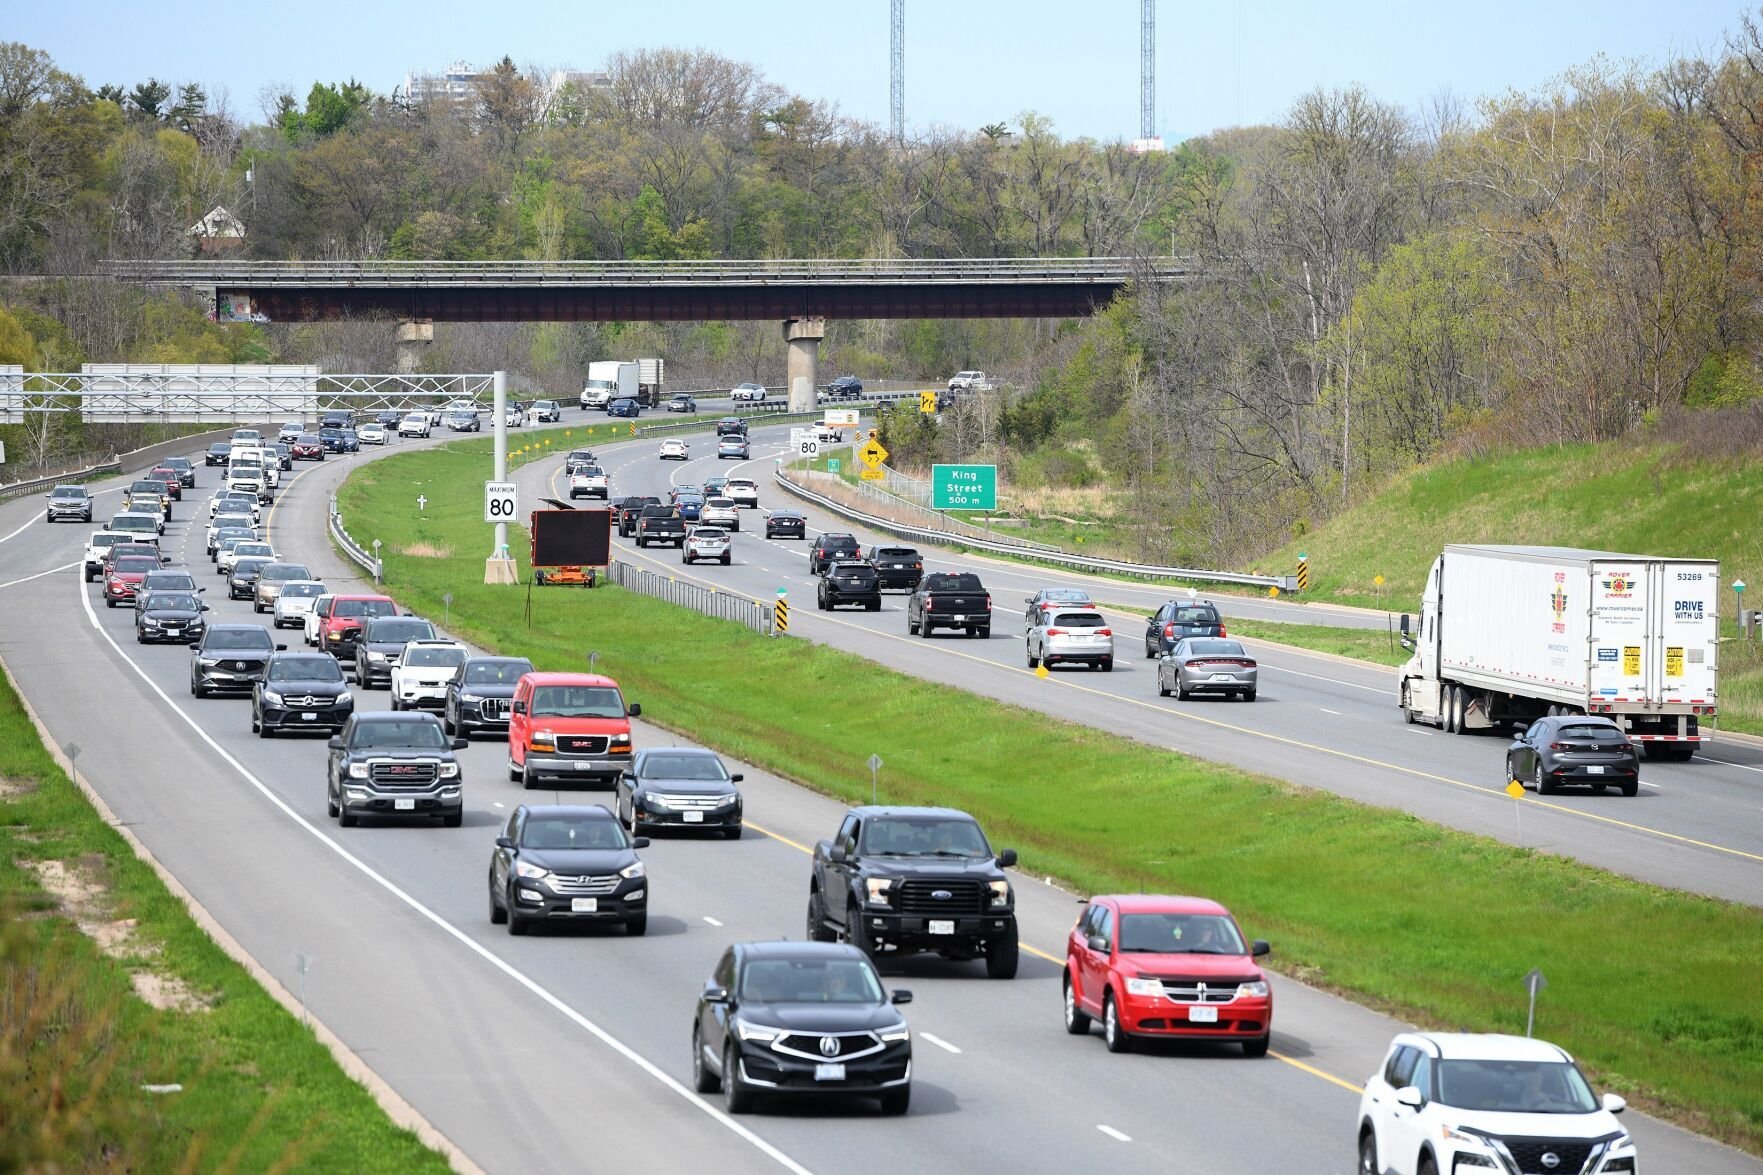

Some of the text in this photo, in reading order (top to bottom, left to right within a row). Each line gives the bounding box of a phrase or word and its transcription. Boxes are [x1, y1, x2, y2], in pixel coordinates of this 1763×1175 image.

[801, 442, 817, 453] 80
[952, 470, 977, 482] King
[947, 483, 983, 493] Street
[948, 496, 968, 504] 500
[490, 498, 514, 516] 80
[1677, 573, 1702, 581] 53269
[1674, 601, 1704, 611] DRIVE
[1694, 612, 1704, 620] US
[391, 766, 417, 774] GMC
